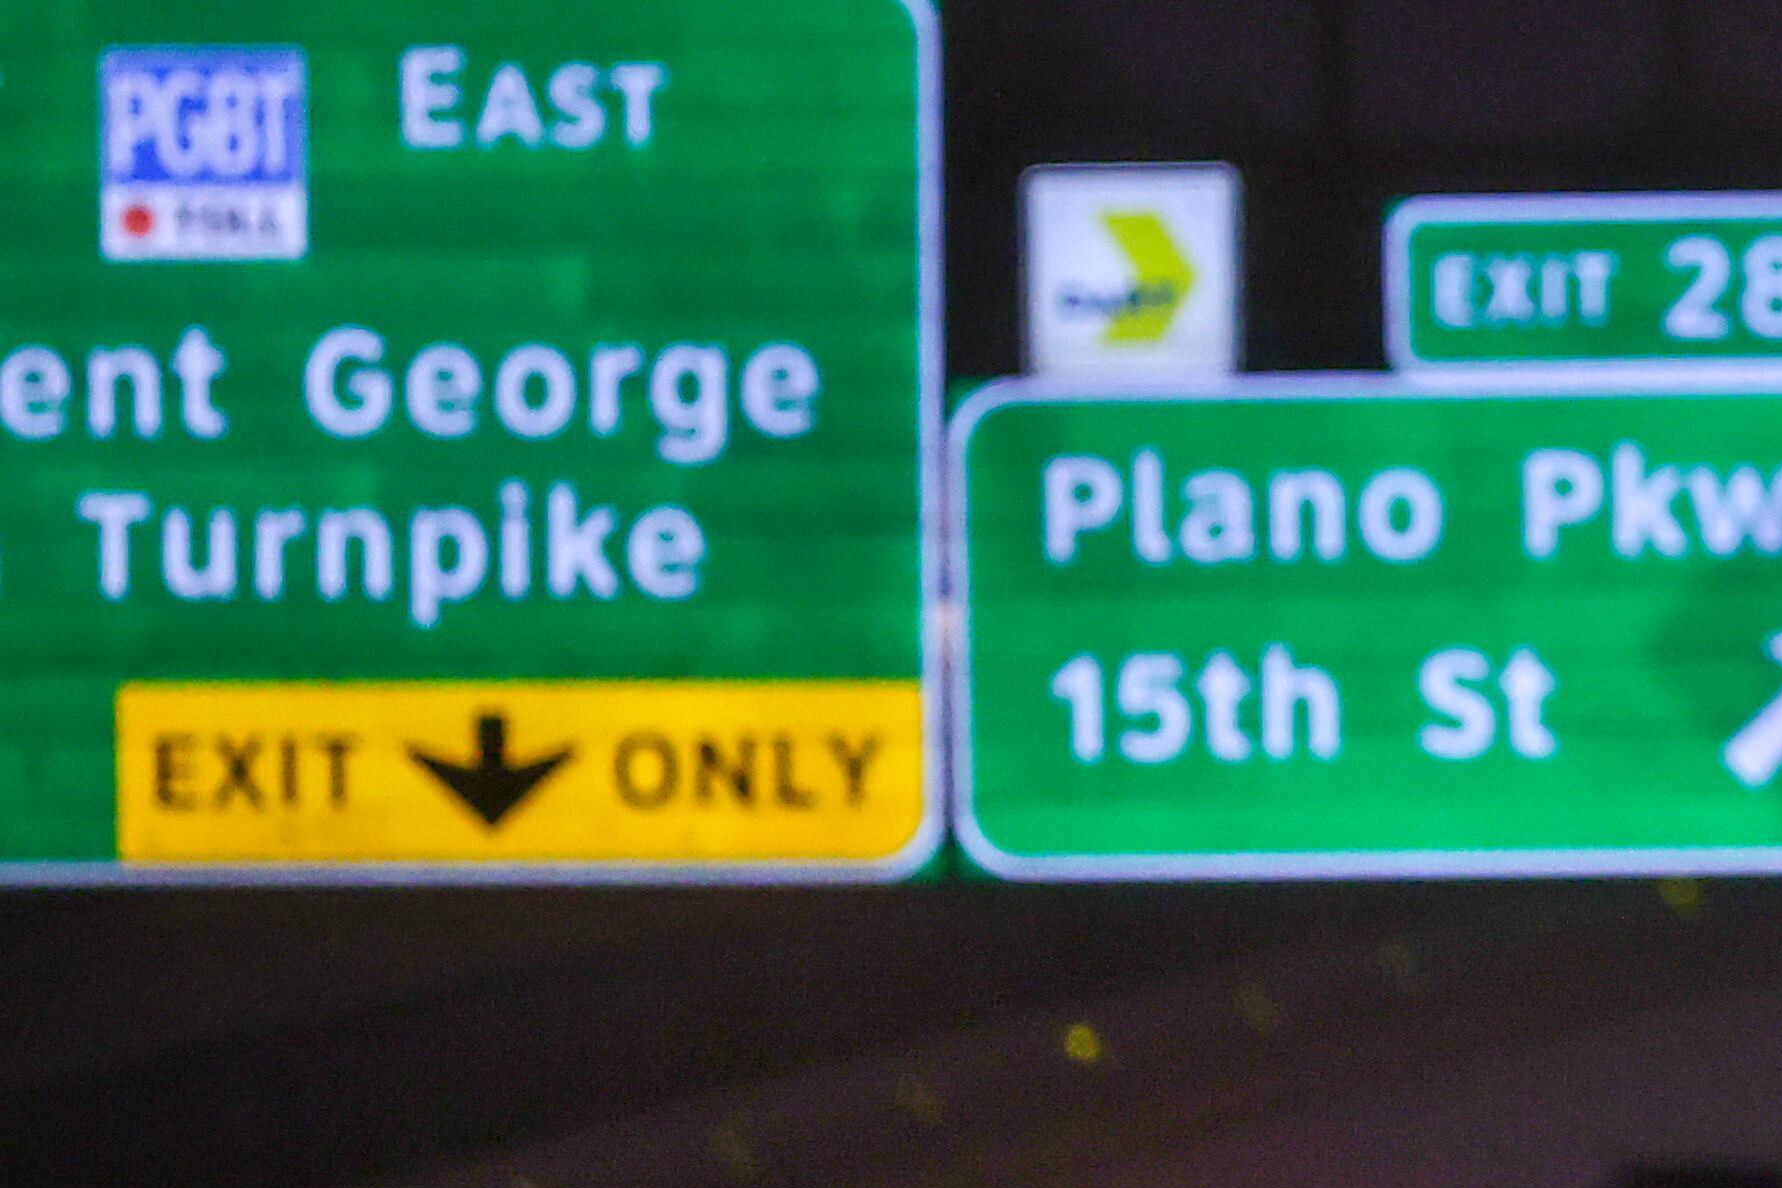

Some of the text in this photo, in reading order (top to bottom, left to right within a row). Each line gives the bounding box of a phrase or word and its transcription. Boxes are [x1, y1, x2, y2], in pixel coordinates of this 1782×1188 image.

[402, 47, 662, 148] EAST
[1434, 252, 1615, 327] EXIT
[0, 328, 818, 463] ent George
[79, 482, 704, 627] Turnpike
[1045, 448, 1443, 564] Plano
[1051, 645, 1558, 763] 15th St
[153, 735, 880, 810] EXIT ONLY
